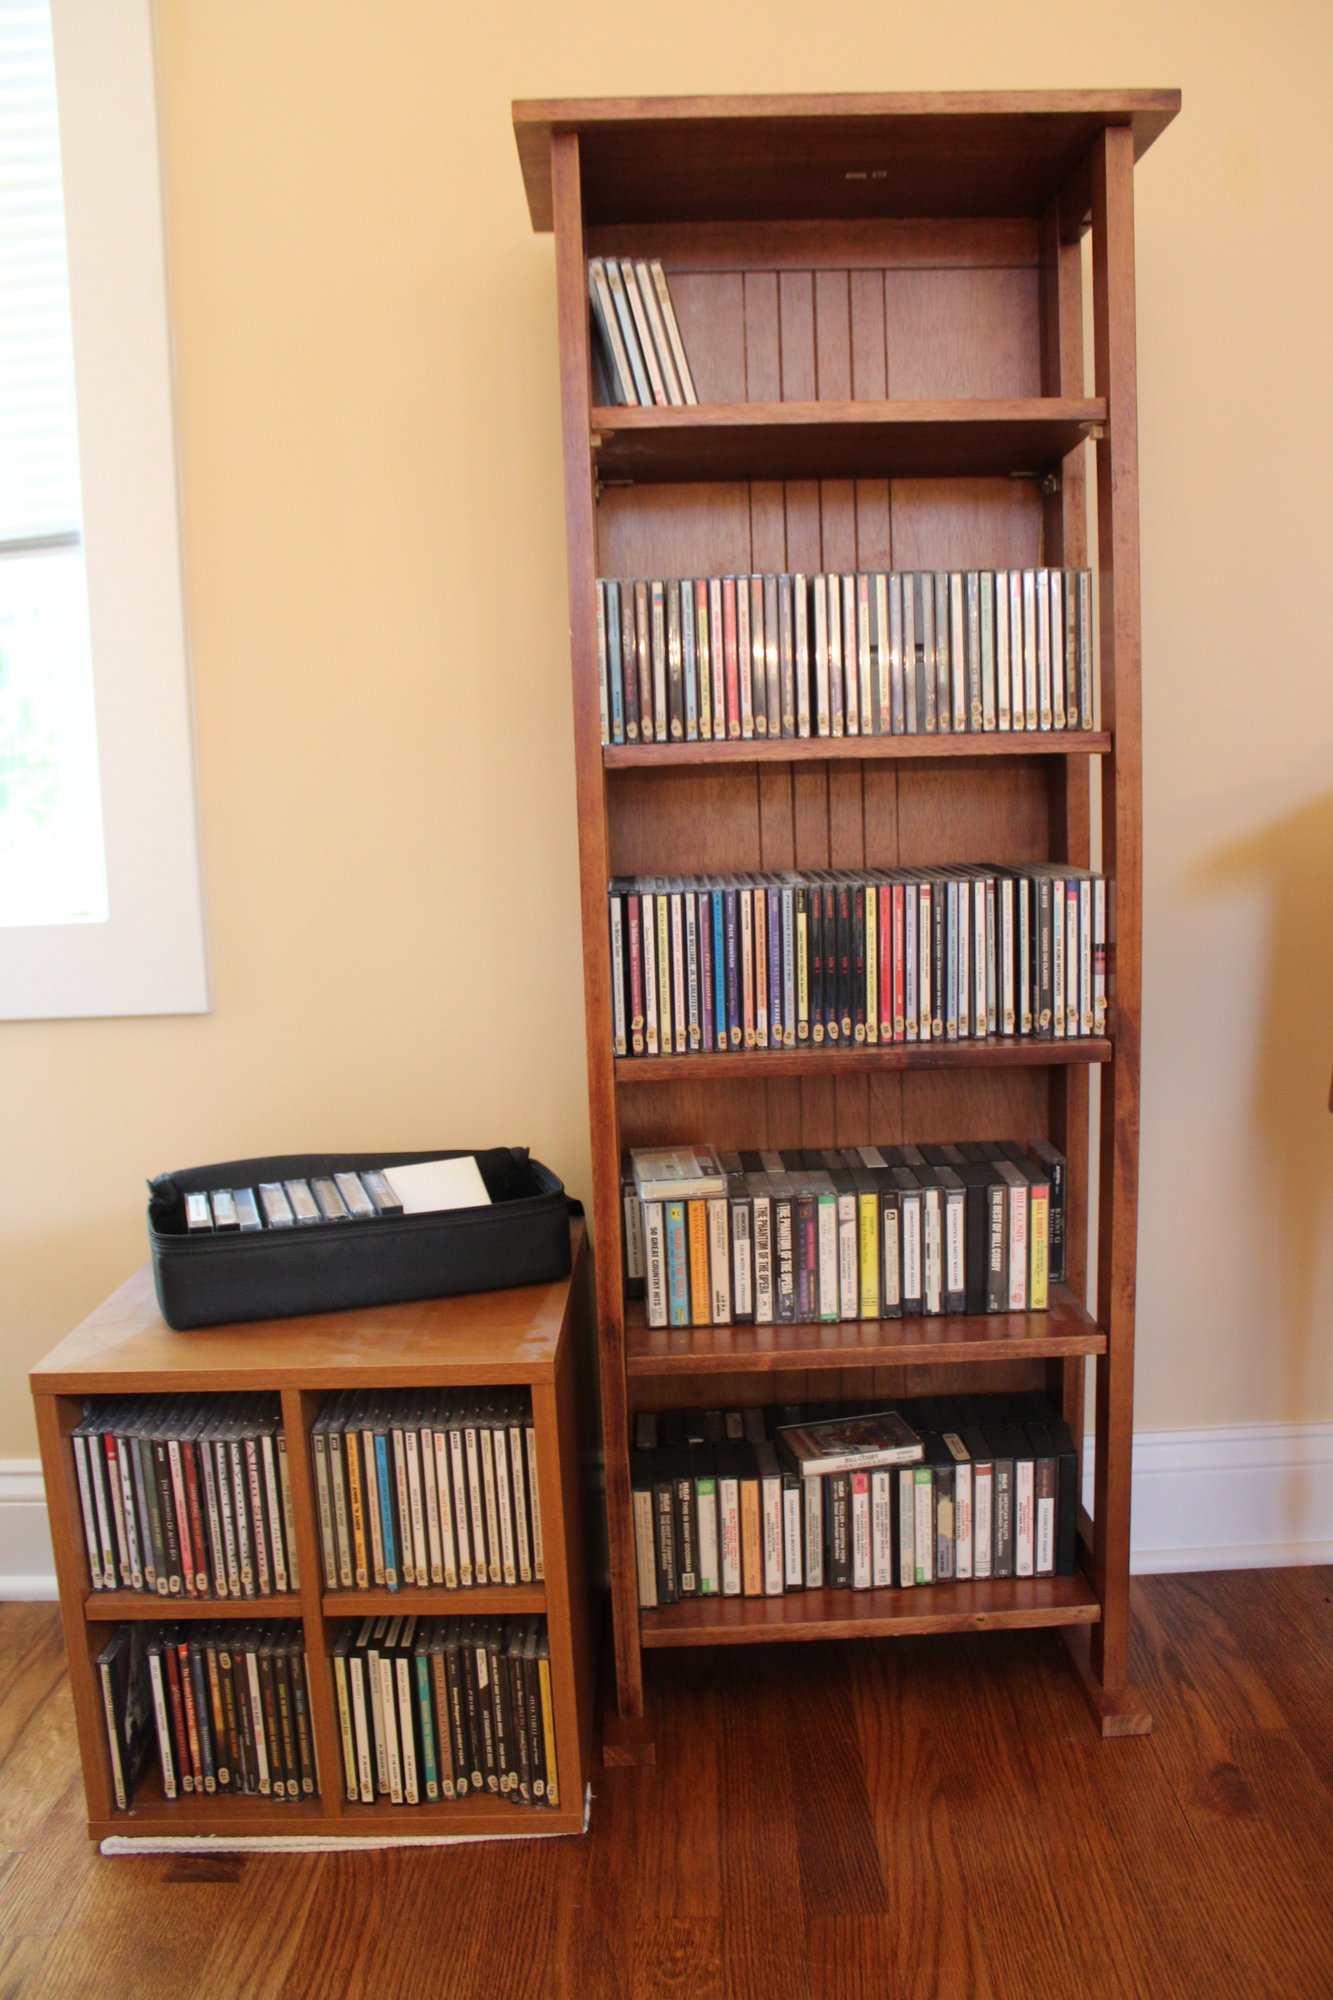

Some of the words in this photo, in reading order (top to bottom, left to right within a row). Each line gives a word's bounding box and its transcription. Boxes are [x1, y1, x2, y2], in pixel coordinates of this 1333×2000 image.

[993, 1192, 1003, 1205] THE
[757, 1206, 767, 1218] THE
[780, 1206, 791, 1218] THE
[993, 1205, 1003, 1223] BEST
[650, 1227, 657, 1236] 50
[757, 1219, 768, 1250] PHANTOM
[780, 1219, 791, 1250] PHANTOM
[993, 1223, 1002, 1233] OF
[1016, 1213, 1025, 1243] COSBY
[650, 1237, 658, 1257] GREAT
[993, 1233, 1002, 1249] BILL
[758, 1251, 768, 1260] OF
[780, 1251, 792, 1259] OF
[992, 1250, 1002, 1271] COSBY
[758, 1261, 768, 1274] THE
[781, 1260, 792, 1273] THE
[652, 1259, 660, 1290] COUNTRY
[758, 1275, 768, 1294] OPERA
[781, 1273, 792, 1294] OPERA
[653, 1291, 661, 1306] HITS
[845, 1455, 857, 1463] BILL
[857, 1453, 879, 1461] COSBY
[682, 1482, 690, 1500] RCA
